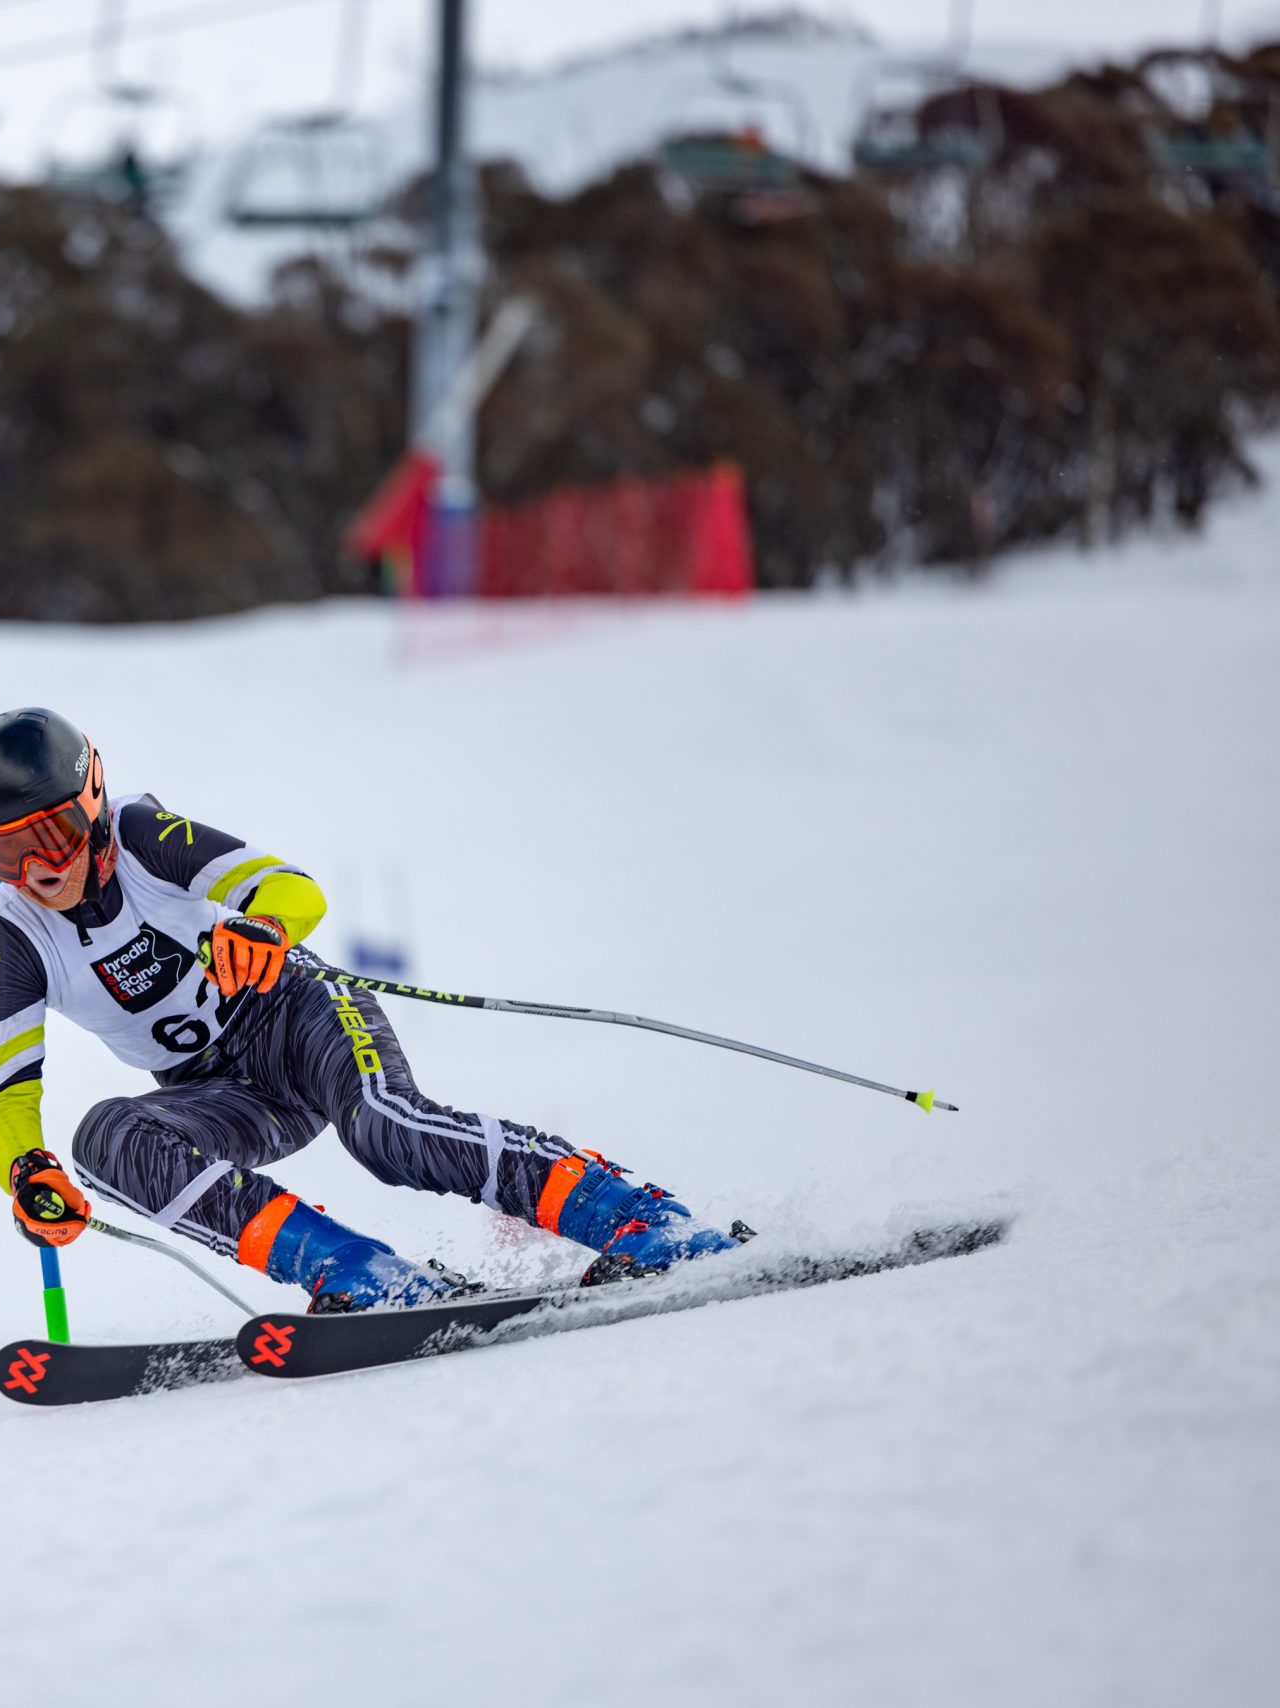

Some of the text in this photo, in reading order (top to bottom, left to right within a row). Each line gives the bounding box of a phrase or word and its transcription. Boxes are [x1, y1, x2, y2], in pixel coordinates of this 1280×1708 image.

[105, 966, 130, 985] ski
[216, 946, 228, 979] racing
[112, 961, 162, 995] racing
[329, 995, 383, 1074] HEAD
[39, 1199, 63, 1215] LEKI
[36, 1227, 68, 1236] racing
